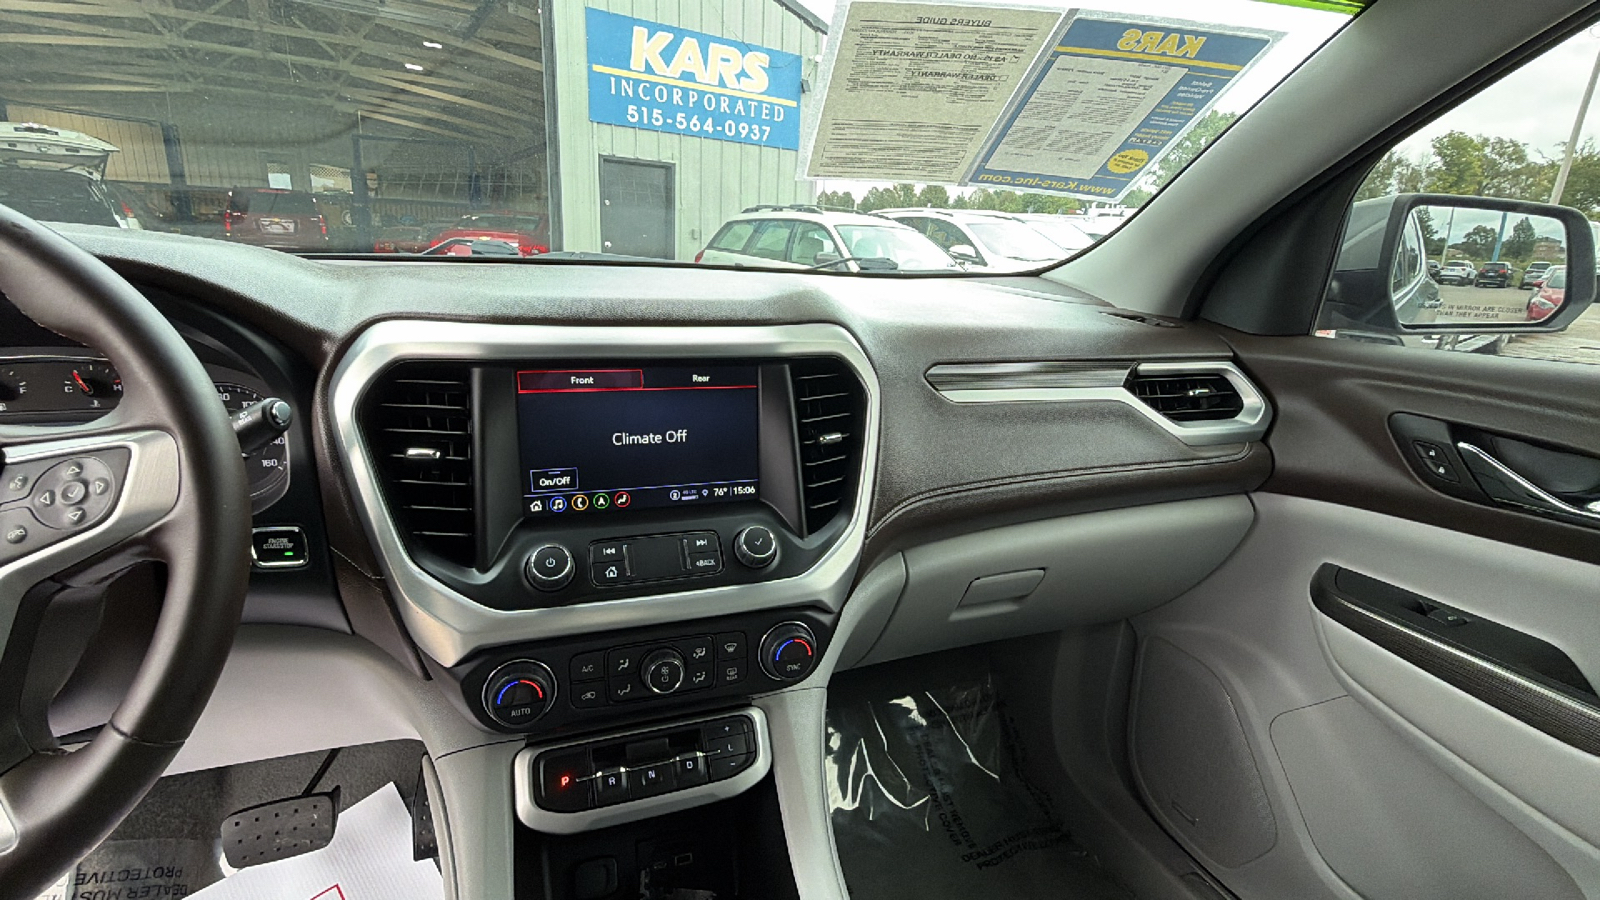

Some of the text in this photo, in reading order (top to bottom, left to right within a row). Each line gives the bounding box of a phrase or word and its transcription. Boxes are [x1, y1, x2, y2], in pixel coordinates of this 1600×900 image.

[630, 26, 770, 93] KARS
[610, 77, 785, 122] INCORPORATED
[626, 105, 771, 142] 515-564-0937
[571, 376, 594, 385] Front
[692, 374, 710, 383] Rear
[19, 386, 27, 394] F
[612, 430, 688, 445] Climate Off
[261, 459, 278, 467] 160
[539, 476, 571, 486] On/Off
[733, 486, 756, 495] 15:06
[511, 707, 531, 717] AUTO
[686, 760, 694, 769] D
[648, 770, 656, 779] N
[561, 776, 570, 786] P
[608, 777, 617, 786] R
[75, 866, 183, 886] PROTECTIVE
